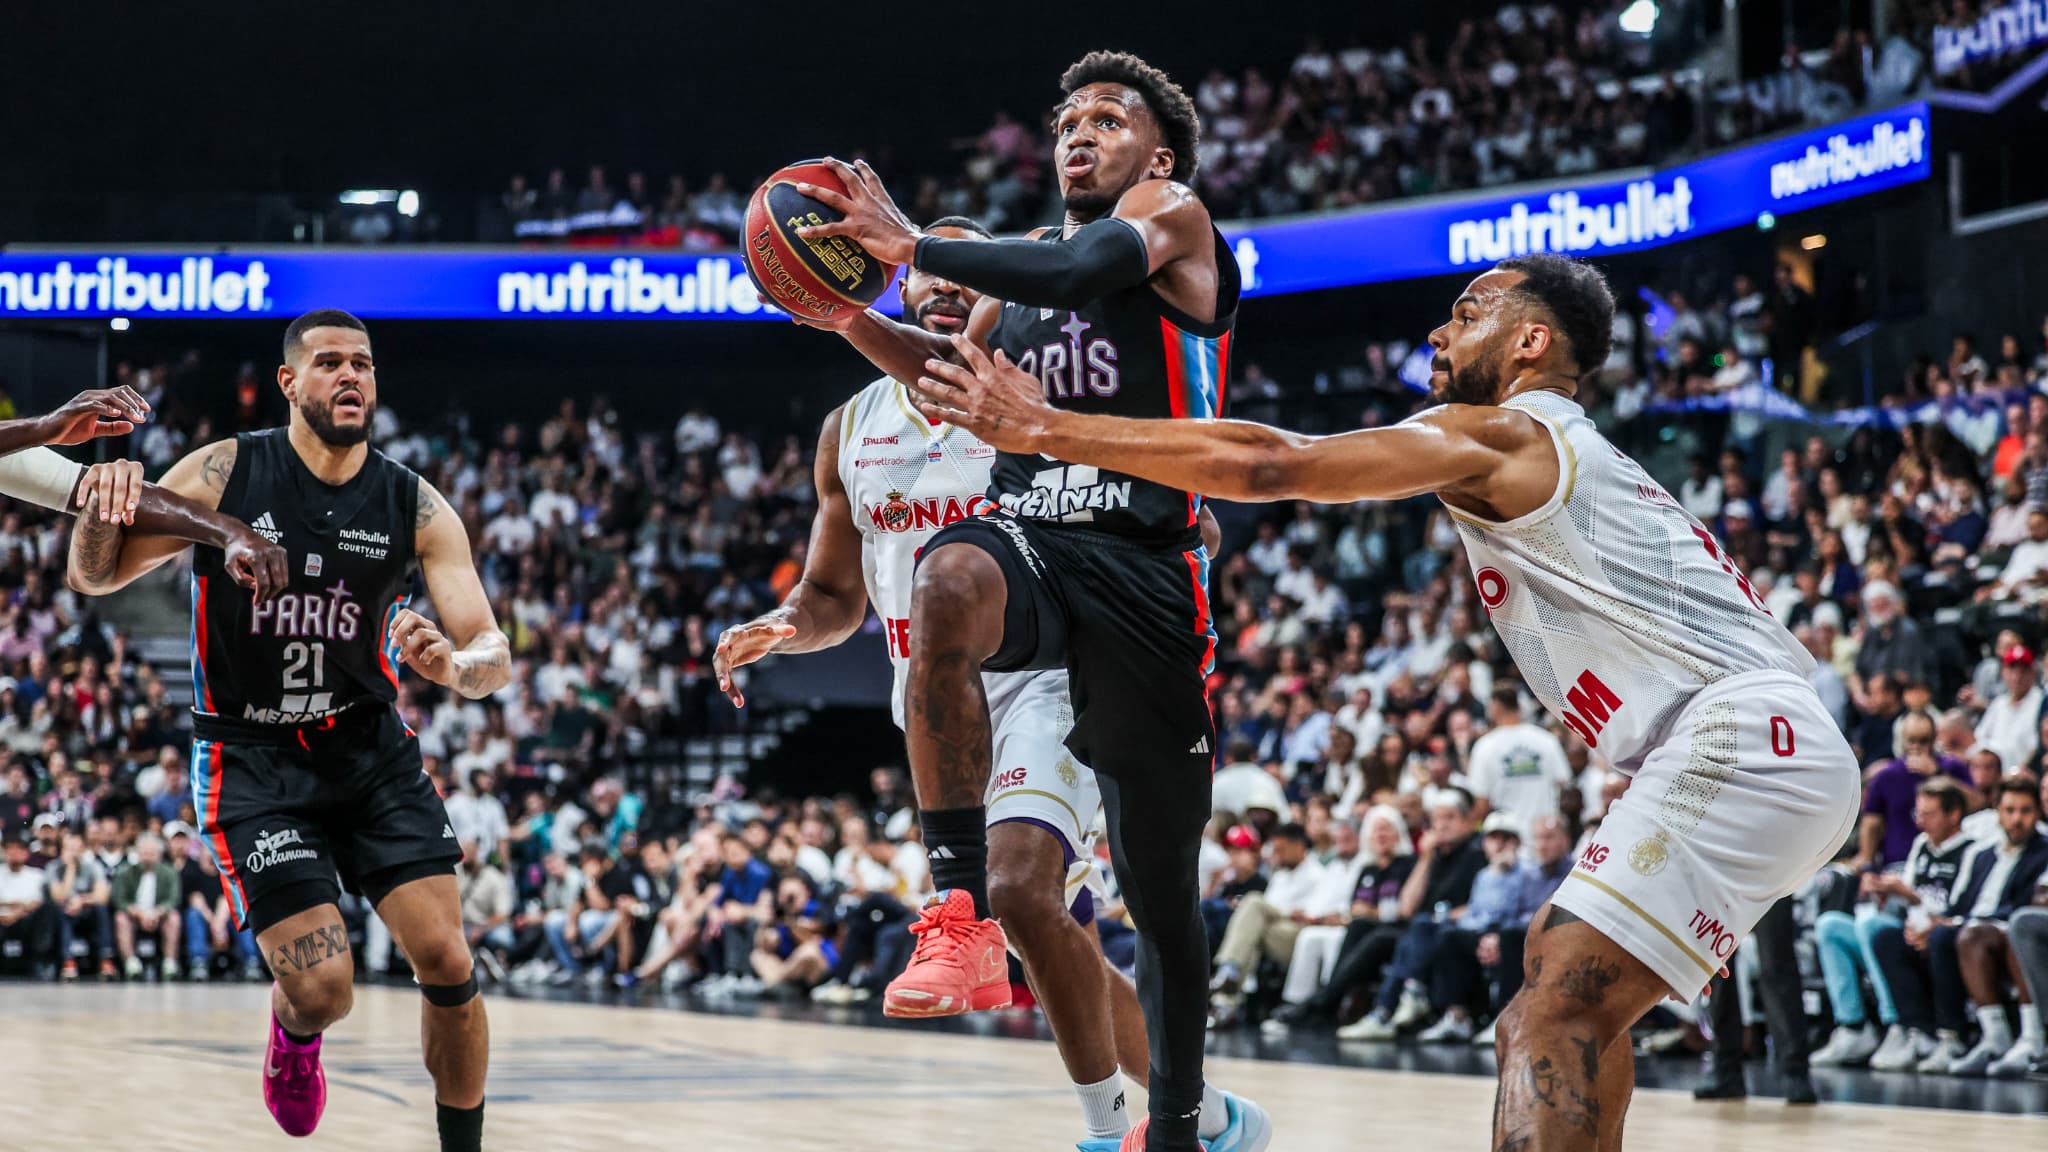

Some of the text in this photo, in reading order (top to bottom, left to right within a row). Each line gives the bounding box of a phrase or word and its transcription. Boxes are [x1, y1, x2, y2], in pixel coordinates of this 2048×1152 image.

[1771, 117, 1925, 199] nutribullet
[1449, 176, 1693, 265] nutribullet
[0, 257, 270, 312] nutribullet
[498, 257, 776, 315] nutribulle
[753, 224, 843, 317] SPALDING
[862, 436, 899, 446] SPALDING
[998, 481, 1132, 519] MENNEN
[337, 541, 389, 557] COURTYARD
[339, 528, 390, 545] nutribullet
[250, 591, 362, 641] PARIS
[283, 641, 324, 689] 21
[1770, 715, 1796, 757] 0
[254, 829, 304, 852] PIZZA
[1688, 909, 1736, 959] TVMO
